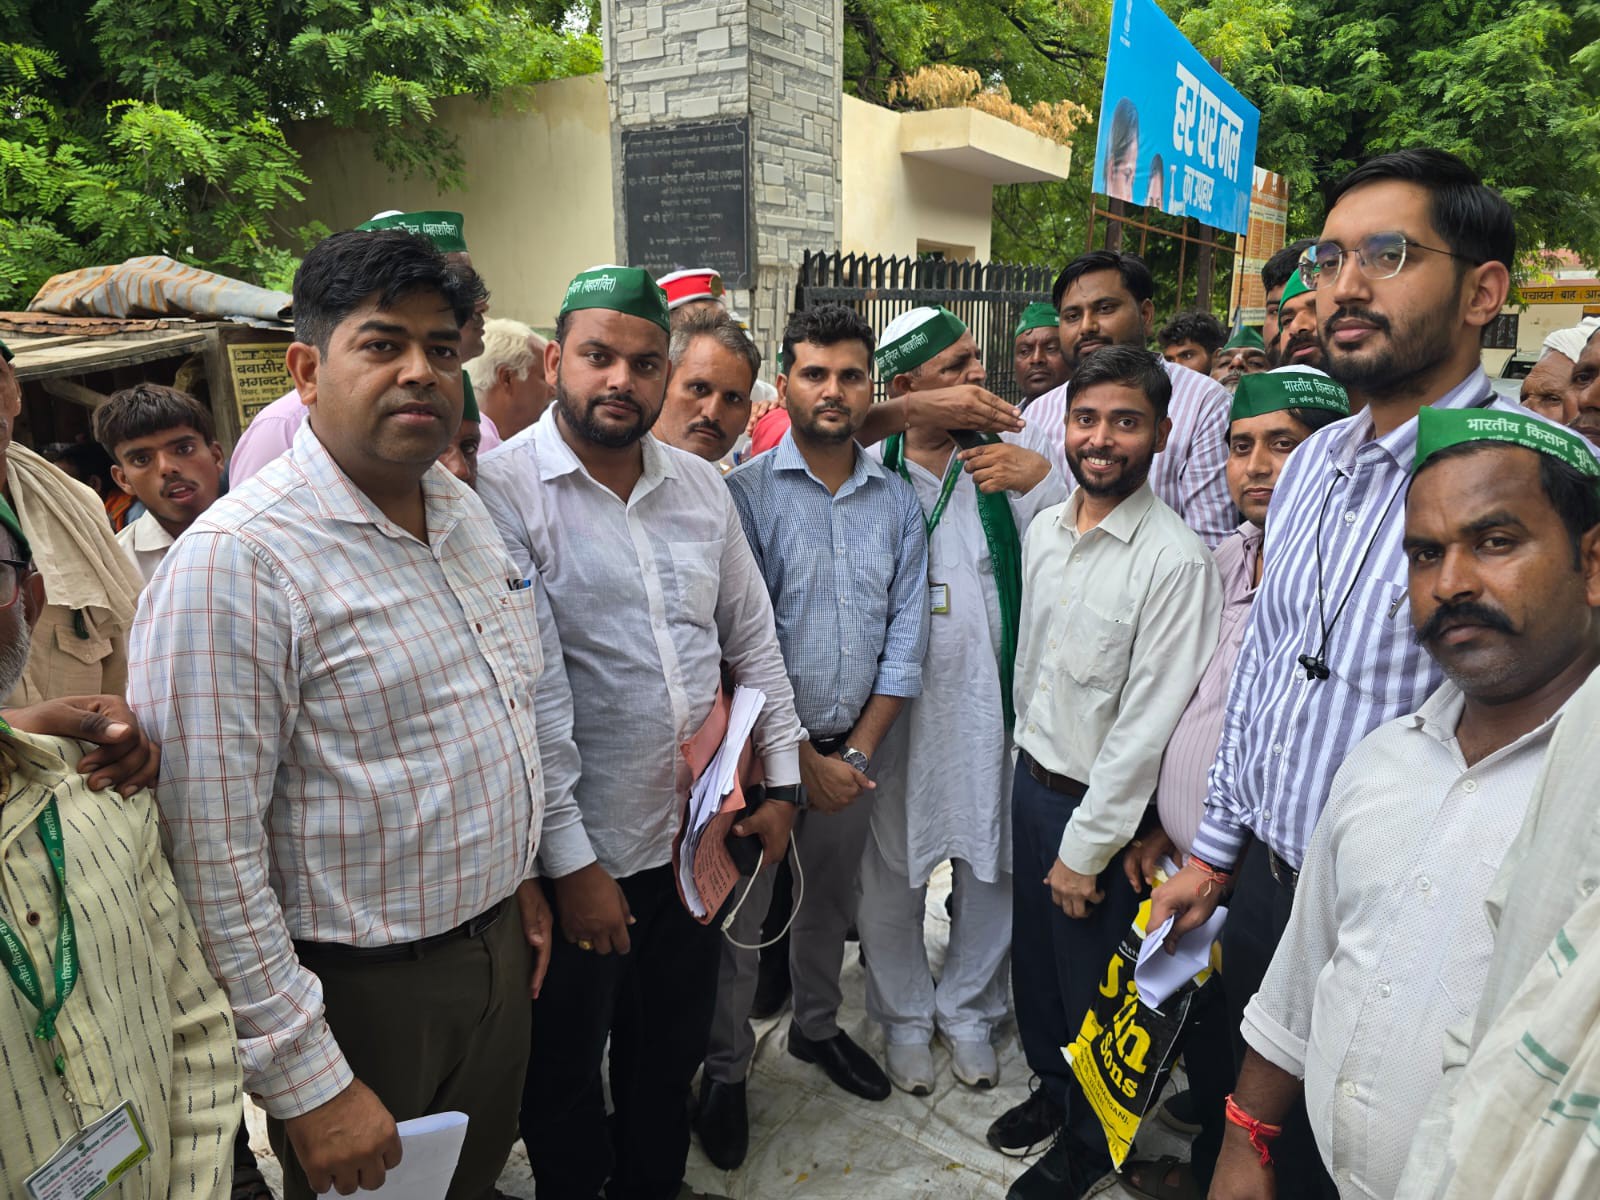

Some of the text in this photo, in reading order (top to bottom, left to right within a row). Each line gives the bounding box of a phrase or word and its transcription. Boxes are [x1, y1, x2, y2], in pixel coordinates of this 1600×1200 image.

[1173, 61, 1243, 183] हर घर नल
[239, 376, 287, 387] भगन्दर
[1283, 378, 1313, 393] भारतीय
[1313, 378, 1337, 397] किसान
[1467, 418, 1520, 434] भारतीय
[1524, 422, 1569, 451] किसान
[4, 933, 24, 966] किसान
[1100, 1030, 1138, 1100] Sons
